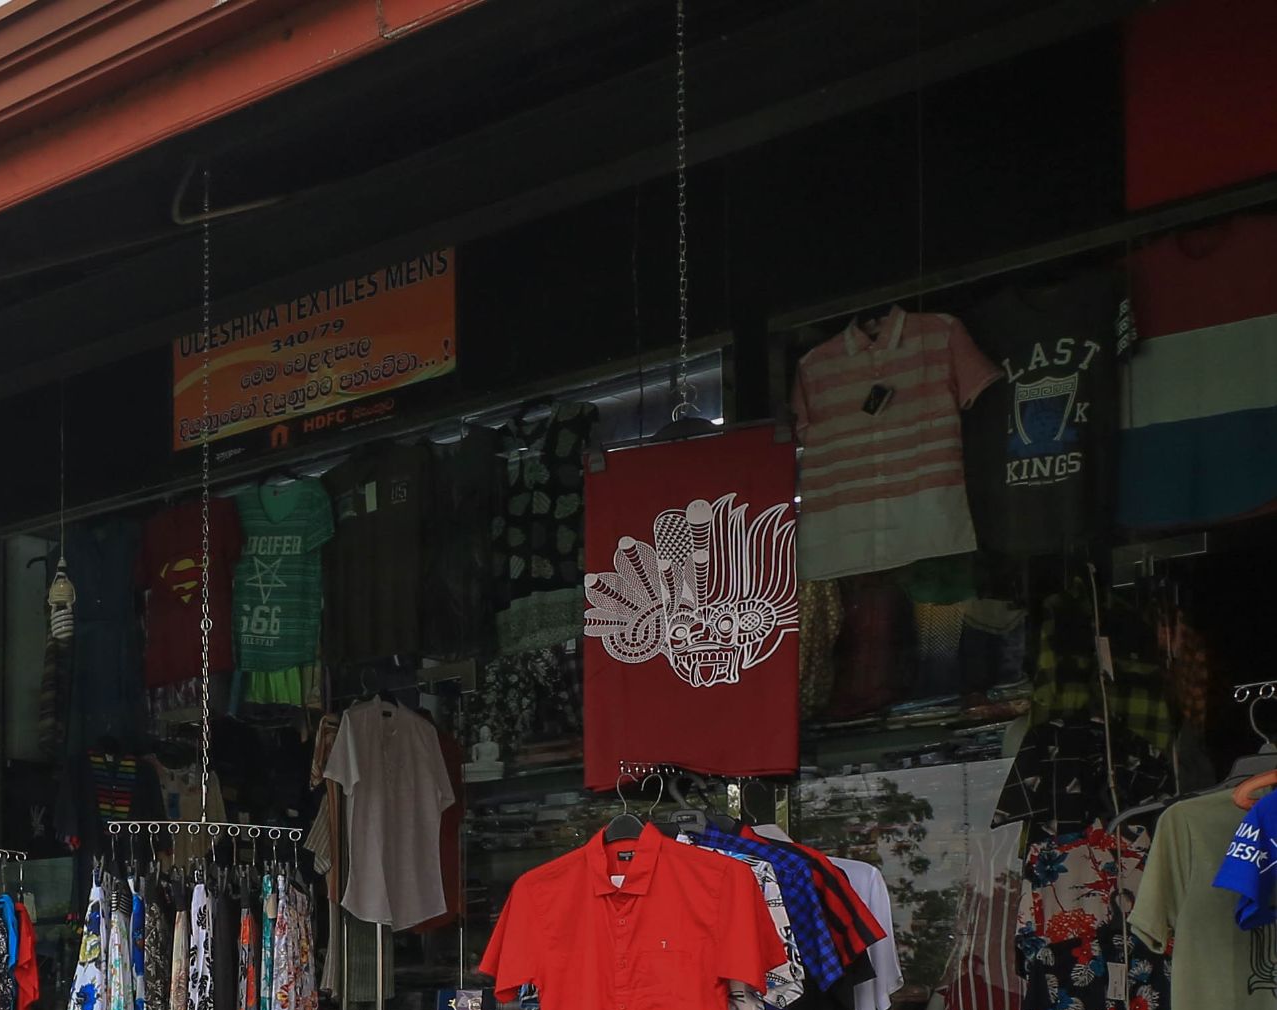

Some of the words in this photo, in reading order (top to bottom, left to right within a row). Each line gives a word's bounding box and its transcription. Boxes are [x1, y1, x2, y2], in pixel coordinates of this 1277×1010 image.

[180, 305, 279, 358] UDESHIKA
[285, 272, 378, 324] TEXTILES
[386, 249, 449, 292] MENS
[271, 319, 345, 354] 340/79
[1002, 337, 1101, 384] LAST
[303, 409, 348, 434] HDFC
[1073, 401, 1090, 423] K
[1005, 451, 1083, 484] KINGS
